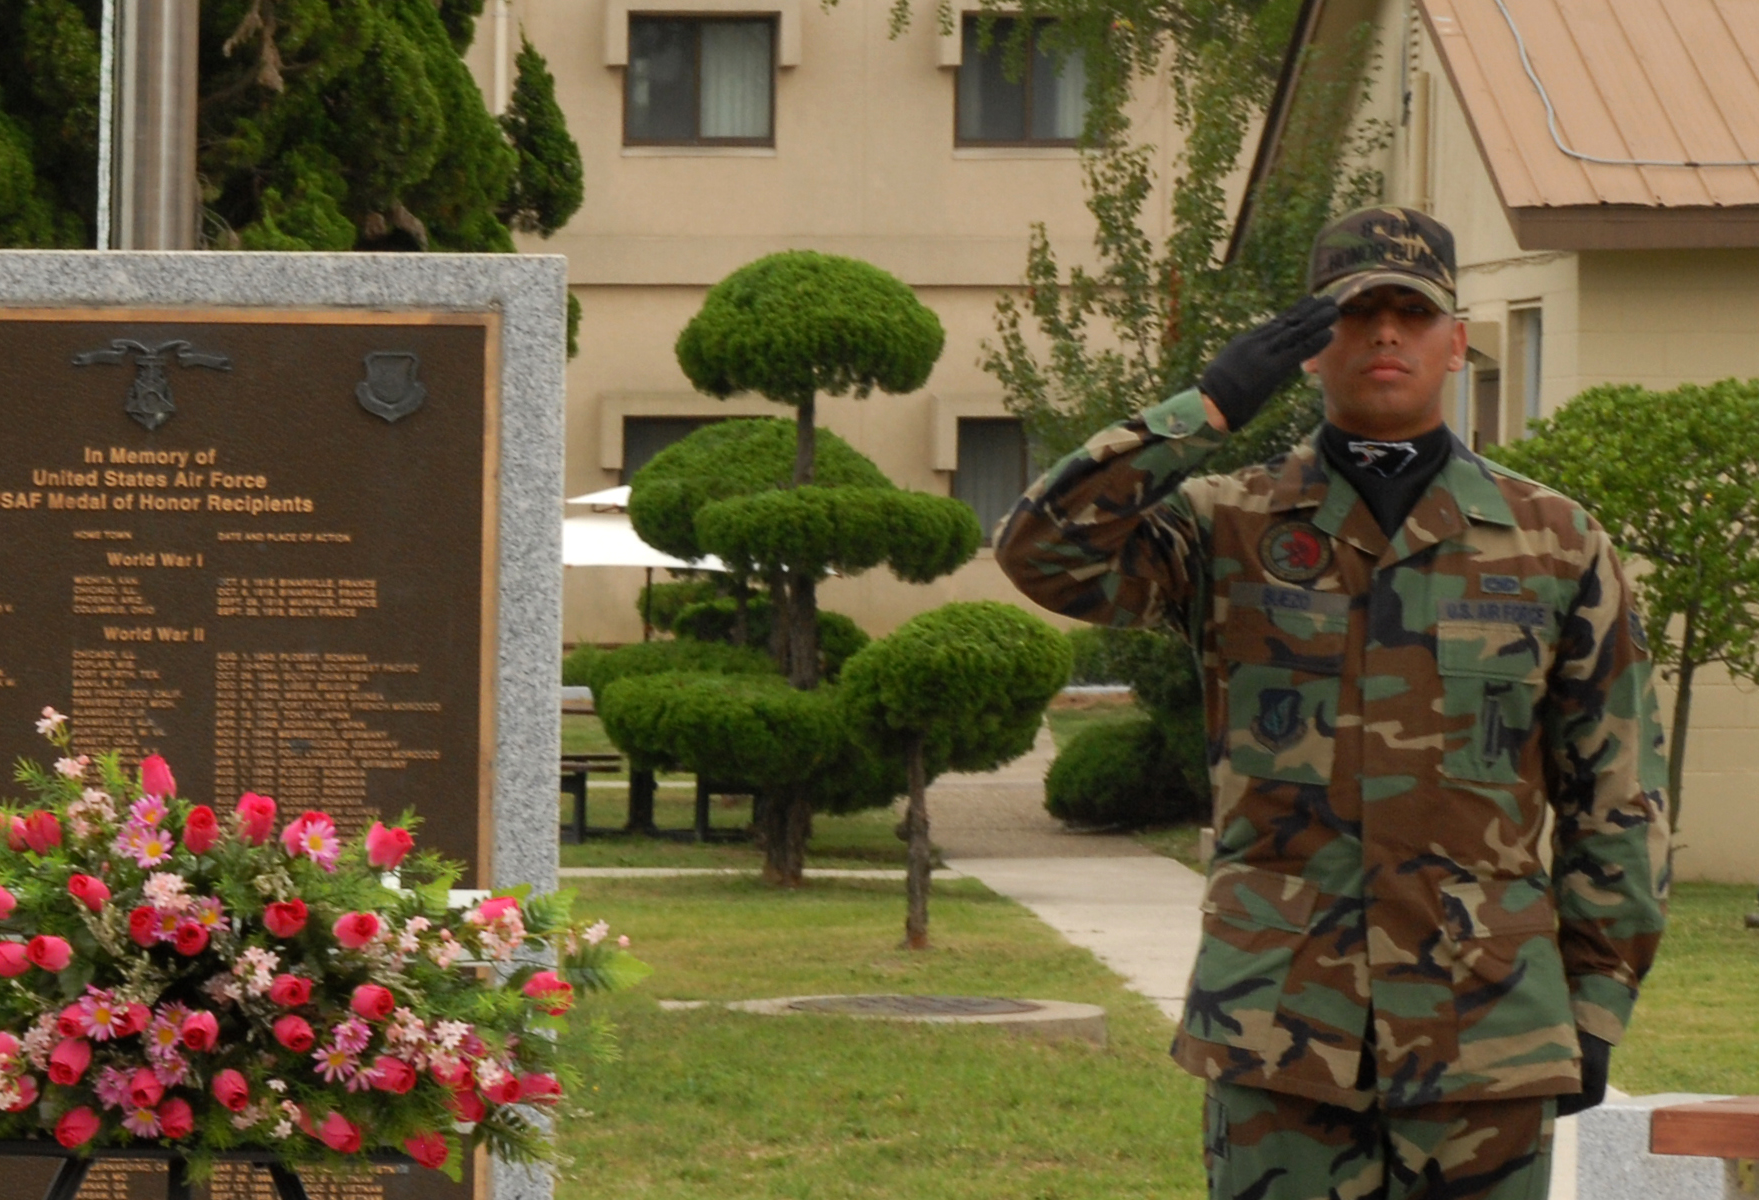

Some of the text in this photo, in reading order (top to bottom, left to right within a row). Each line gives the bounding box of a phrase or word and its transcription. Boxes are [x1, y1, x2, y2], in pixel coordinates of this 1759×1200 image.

[1329, 242, 1386, 271] HONOR
[84, 447, 217, 468] In Memory of
[32, 469, 268, 489] United States Air Force
[48, 493, 107, 510] Medal
[112, 493, 134, 510] of
[138, 494, 202, 511] Honor
[207, 494, 315, 515] Recipients
[73, 530, 133, 540] HOME TOWN
[217, 532, 351, 542] DATE AND PLACE OF ACTION
[106, 551, 204, 567] World War I
[338, 579, 377, 588] FRANCE
[338, 588, 377, 597] FRANCE
[339, 598, 378, 607] FRANCE
[318, 608, 357, 617] FRANCE
[1446, 602, 1545, 625] U.S. AIR FORCE
[103, 626, 205, 641] World War II
